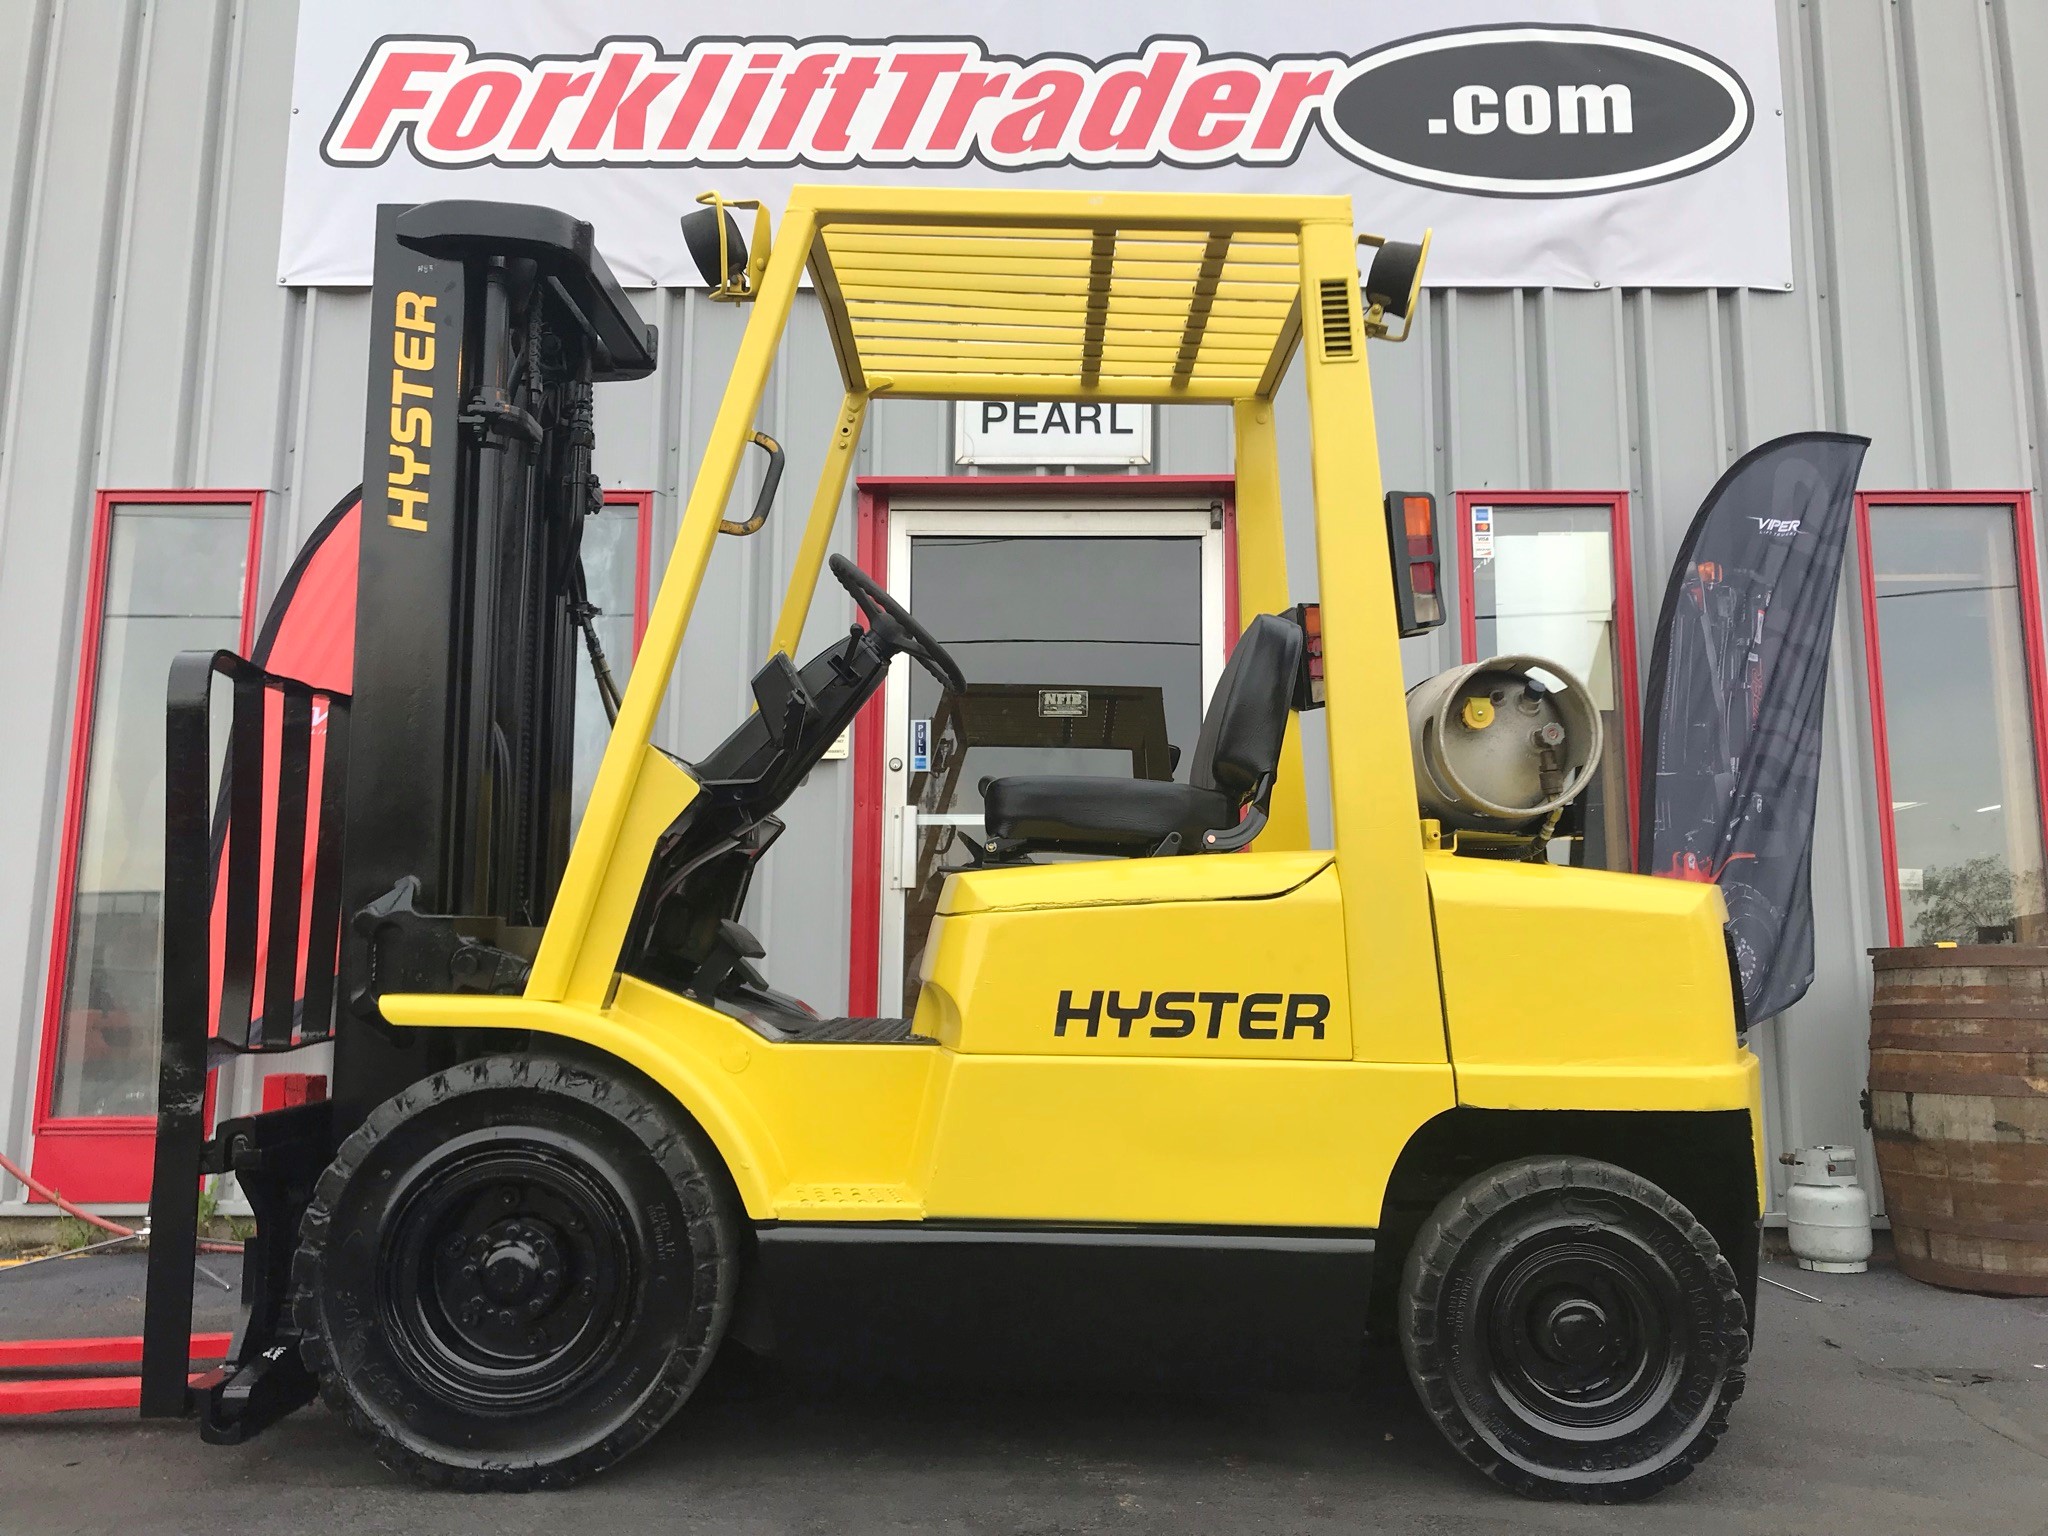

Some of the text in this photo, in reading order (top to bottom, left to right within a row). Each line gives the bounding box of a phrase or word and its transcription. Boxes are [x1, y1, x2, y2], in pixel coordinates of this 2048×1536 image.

[338, 50, 1334, 155] ForkliftTrader
[387, 290, 437, 532] HYSTER
[981, 401, 1134, 434] PEARL
[1756, 517, 1803, 533] VIPER
[1054, 990, 1331, 1040] HYSTER
